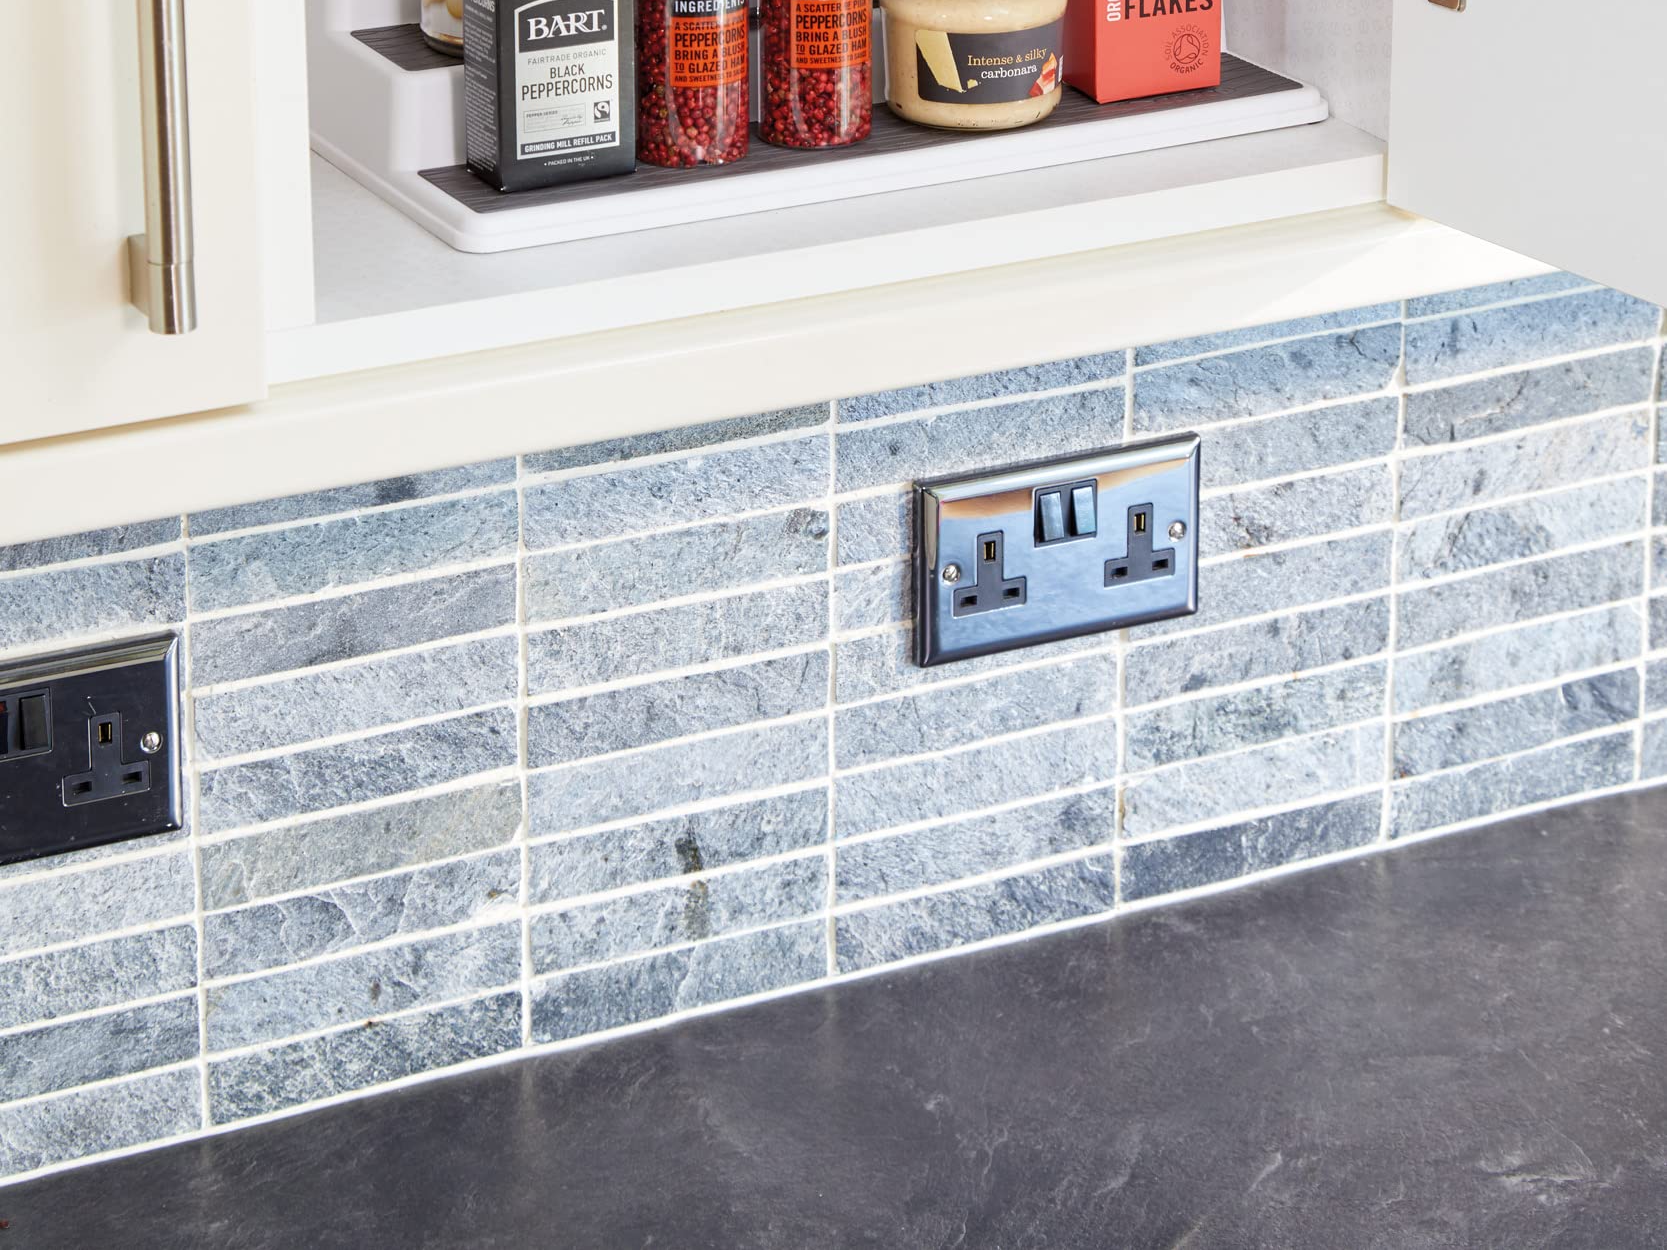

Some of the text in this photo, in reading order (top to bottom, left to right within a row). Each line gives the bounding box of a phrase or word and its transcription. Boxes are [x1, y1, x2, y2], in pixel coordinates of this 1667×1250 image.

[796, 3, 802, 13] A
[804, 2, 842, 13] SCATTER
[675, 21, 680, 31] A
[796, 10, 867, 29] PEPPERCORNS
[675, 24, 745, 48] PEPPERCORNS
[796, 25, 867, 42] BRING A BLUSH
[675, 41, 745, 61] BRING A BLUSH
[796, 38, 867, 55] TO GLAZED HAM
[527, 48, 607, 65] FAIRTRADE ORGANIC
[967, 48, 1047, 66] Intense & silky
[550, 63, 585, 79] BLACK
[675, 62, 685, 71] TO
[688, 60, 728, 74] GLAZED
[980, 64, 1038, 79] carbonara
[1170, 58, 1204, 74] ORGANIC
[521, 73, 613, 101] PEPPERCORNS
[524, 133, 613, 153] GRINDING MILL REFILL PACK
